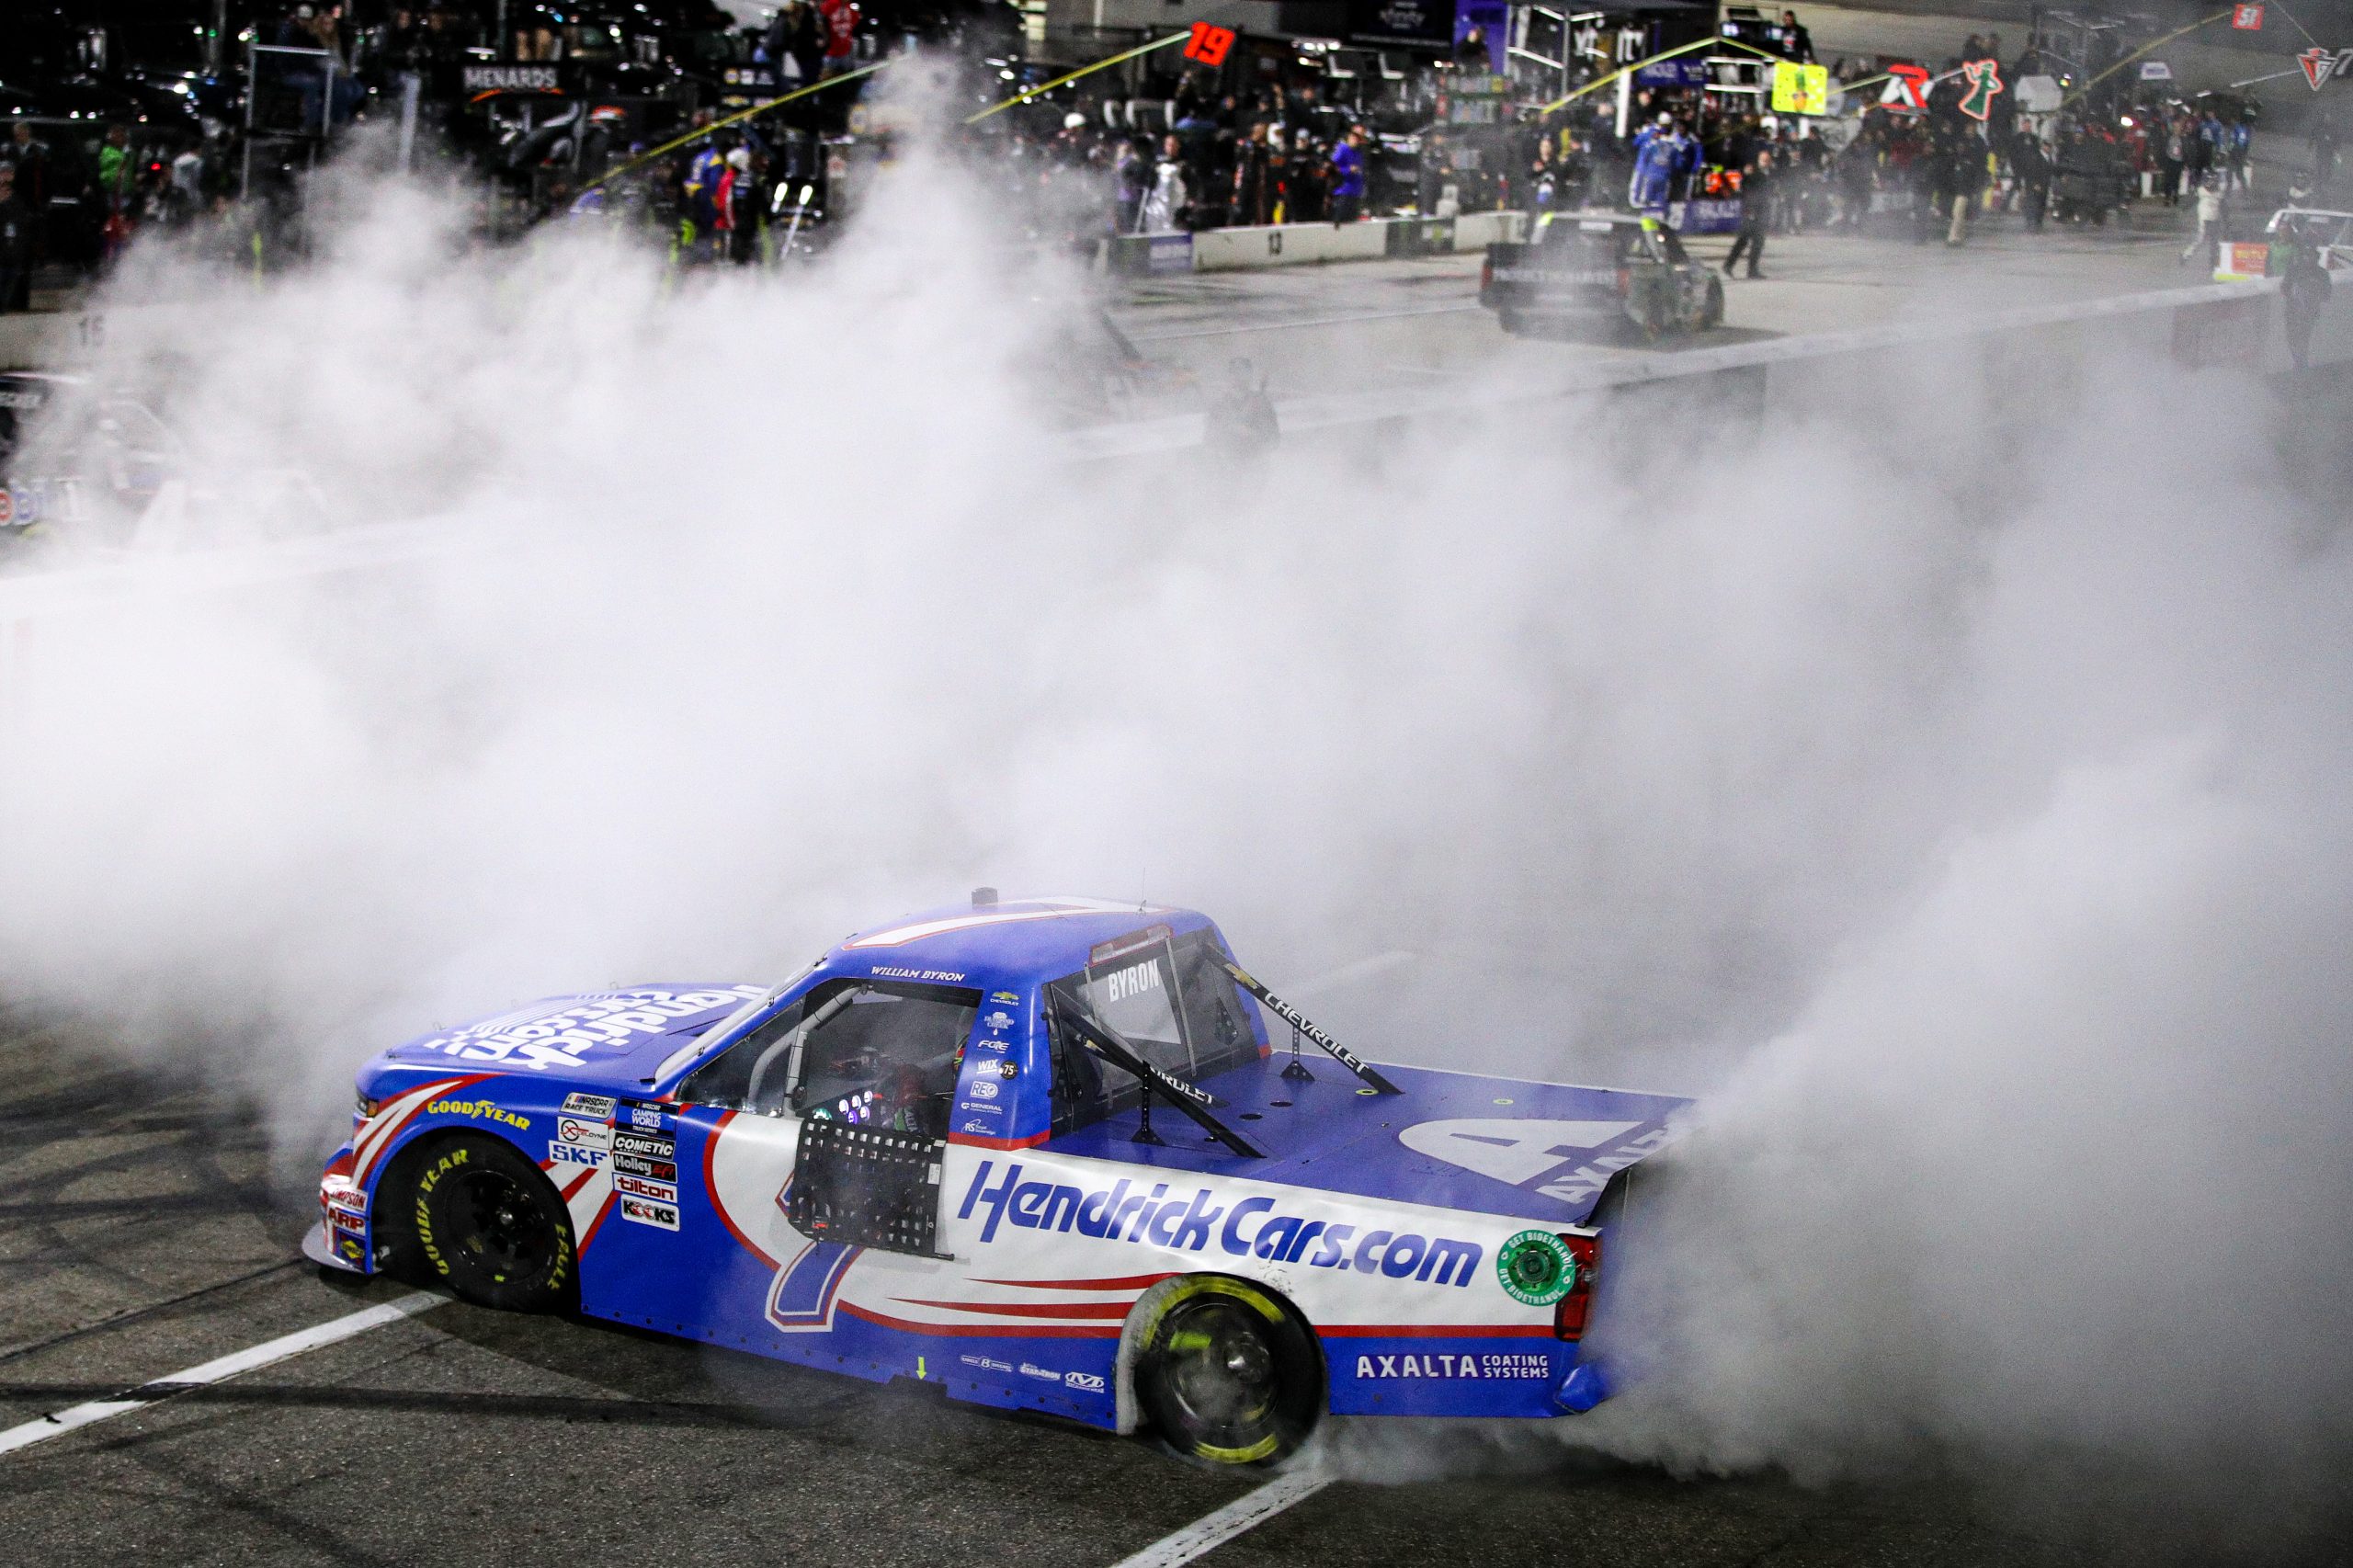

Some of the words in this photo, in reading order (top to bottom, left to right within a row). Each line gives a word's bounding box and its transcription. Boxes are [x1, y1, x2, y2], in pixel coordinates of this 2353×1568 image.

[1183, 21, 1235, 67] 19
[464, 67, 557, 88] MENARDS
[871, 966, 921, 979] WILLIAM
[921, 971, 965, 982] BYRON
[1108, 958, 1160, 1002] BYRON
[1265, 993, 1369, 1074] CHEVROLET
[978, 1059, 999, 1071] WIX
[1003, 1065, 1015, 1075] 75
[564, 1103, 584, 1113] RACE
[584, 1106, 608, 1116] TRUCK
[580, 1095, 609, 1108] NASCAR
[641, 1103, 662, 1111] NASCAR
[971, 1103, 1003, 1111] GENERAL
[631, 1115, 661, 1128] WORLD
[632, 1108, 662, 1120] CAMPING
[552, 1144, 608, 1166] SKF
[615, 1137, 674, 1156] COMETIC
[615, 1154, 652, 1176] Holley
[617, 1176, 674, 1200] tilton
[328, 1208, 365, 1230] ARP
[623, 1199, 676, 1224] KOOKS
[958, 1161, 1483, 1288] HendrickCars.com
[1508, 1234, 1526, 1249] GET
[1498, 1268, 1512, 1285] GET
[1356, 1356, 1479, 1379] AXALTA
[1482, 1355, 1549, 1367] COATING
[1483, 1367, 1550, 1379] SYSTEMS
